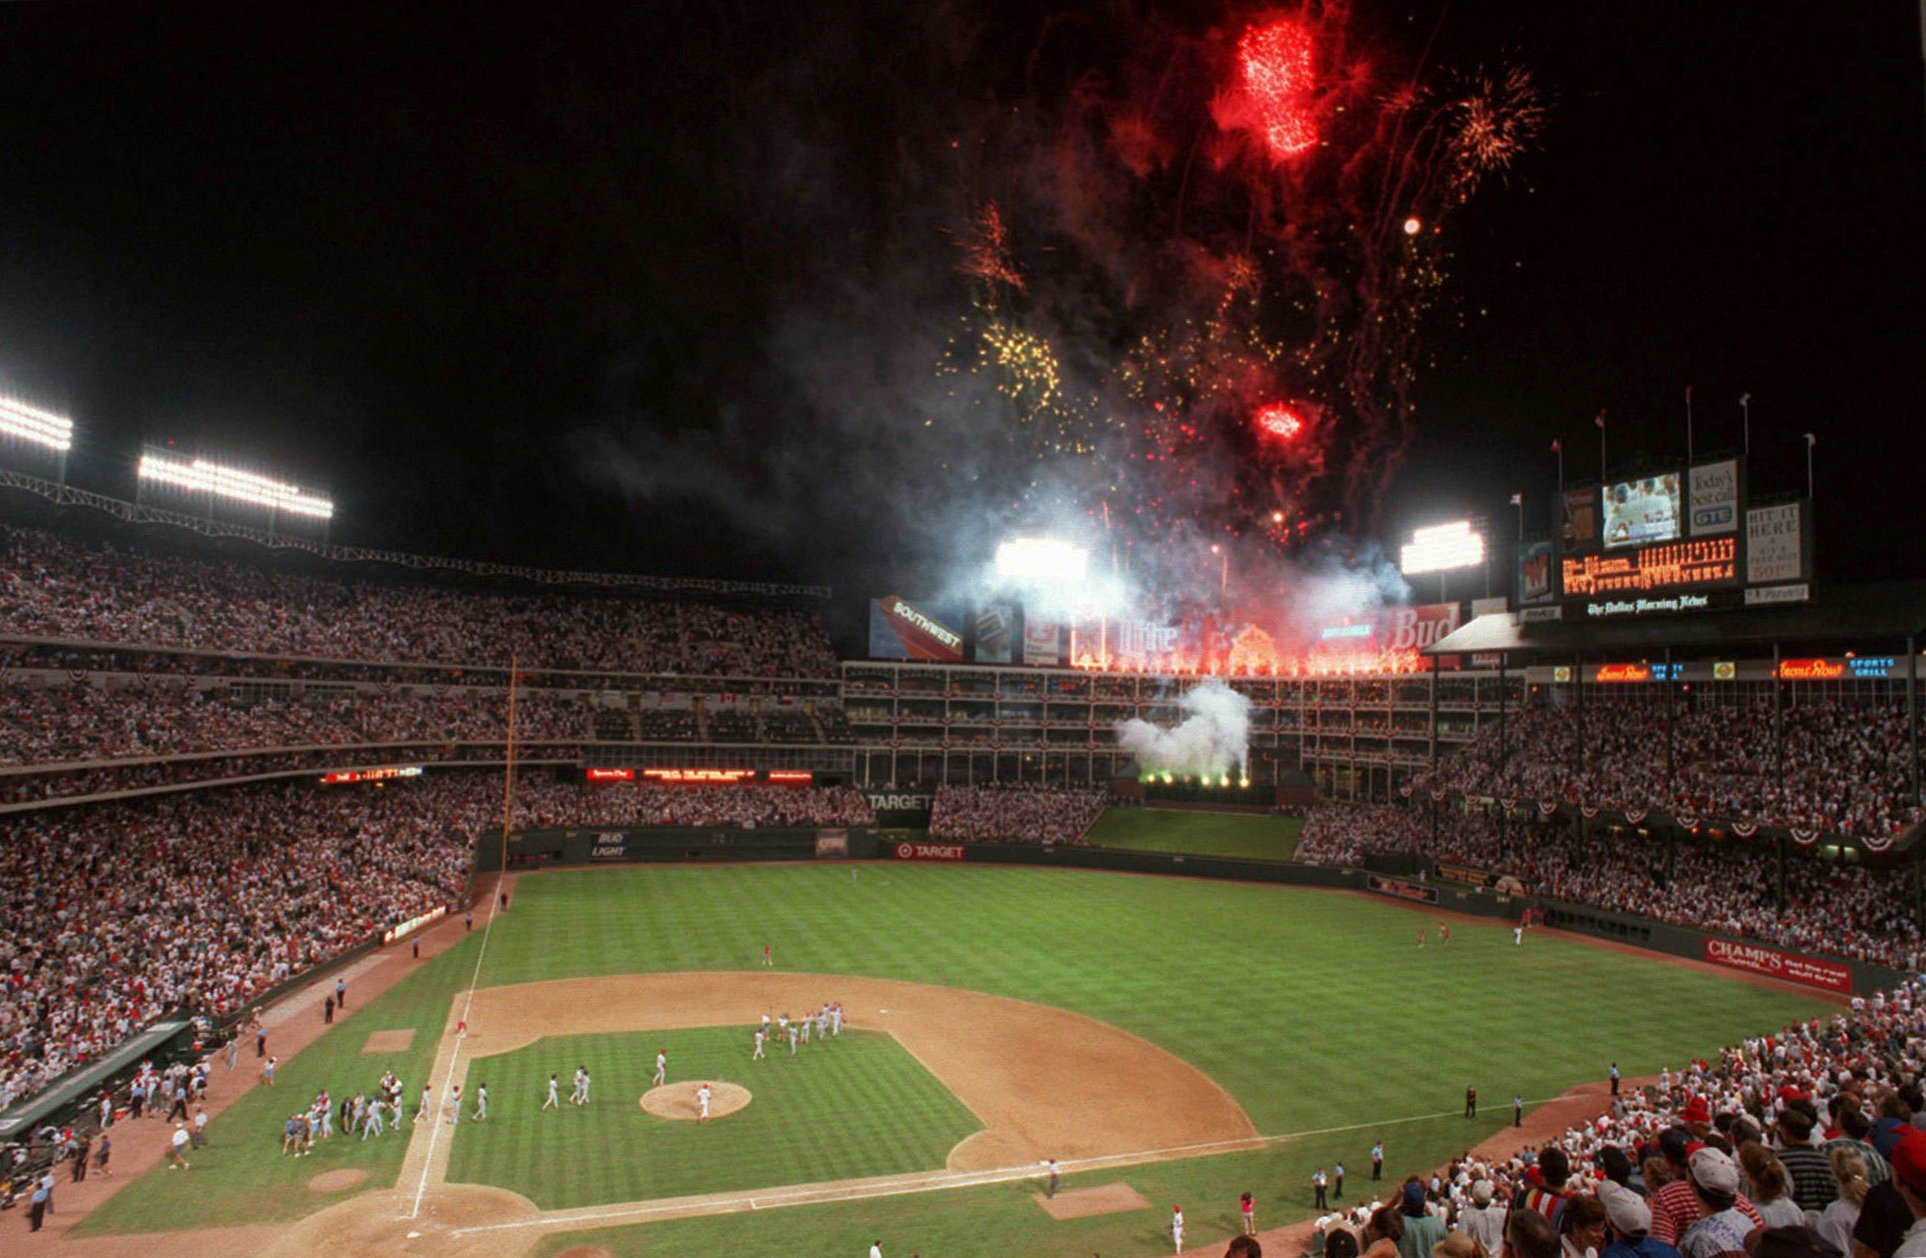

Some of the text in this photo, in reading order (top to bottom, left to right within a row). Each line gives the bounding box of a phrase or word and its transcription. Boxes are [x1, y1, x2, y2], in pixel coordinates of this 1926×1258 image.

[1749, 506, 1797, 523] HIT IT
[1749, 519, 1797, 537] HERE
[1587, 594, 1709, 616] The Dallas Morning News
[893, 601, 961, 648] SOUTHWEST
[1393, 604, 1459, 649] Bud
[1651, 664, 1684, 672] SPOTS
[1811, 659, 1843, 678] Row
[1849, 658, 1895, 668] SPORTS
[1855, 668, 1888, 677] GRILL
[868, 794, 931, 810] TARGET
[598, 832, 624, 844] BUD
[592, 846, 625, 857] LIGHT
[915, 845, 964, 858] TARGET
[1708, 939, 1782, 970] CHAMPS
